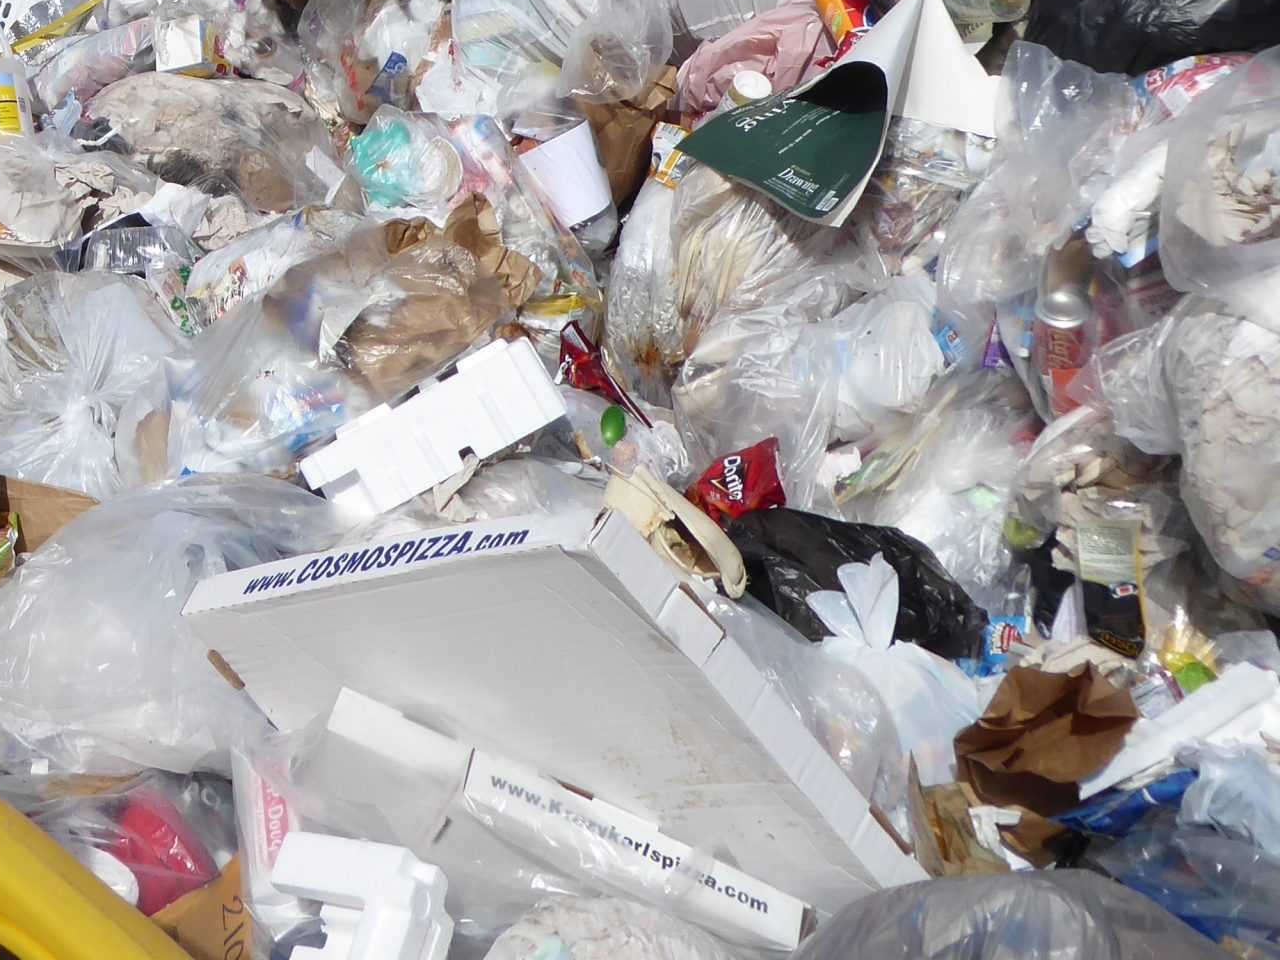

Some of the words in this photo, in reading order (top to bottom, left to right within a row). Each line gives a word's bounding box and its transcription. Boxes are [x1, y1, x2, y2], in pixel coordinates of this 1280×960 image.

[778, 166, 820, 196] Drawing
[723, 455, 744, 504] Dorito
[242, 529, 531, 595] www.COSMOSPIZZA.com
